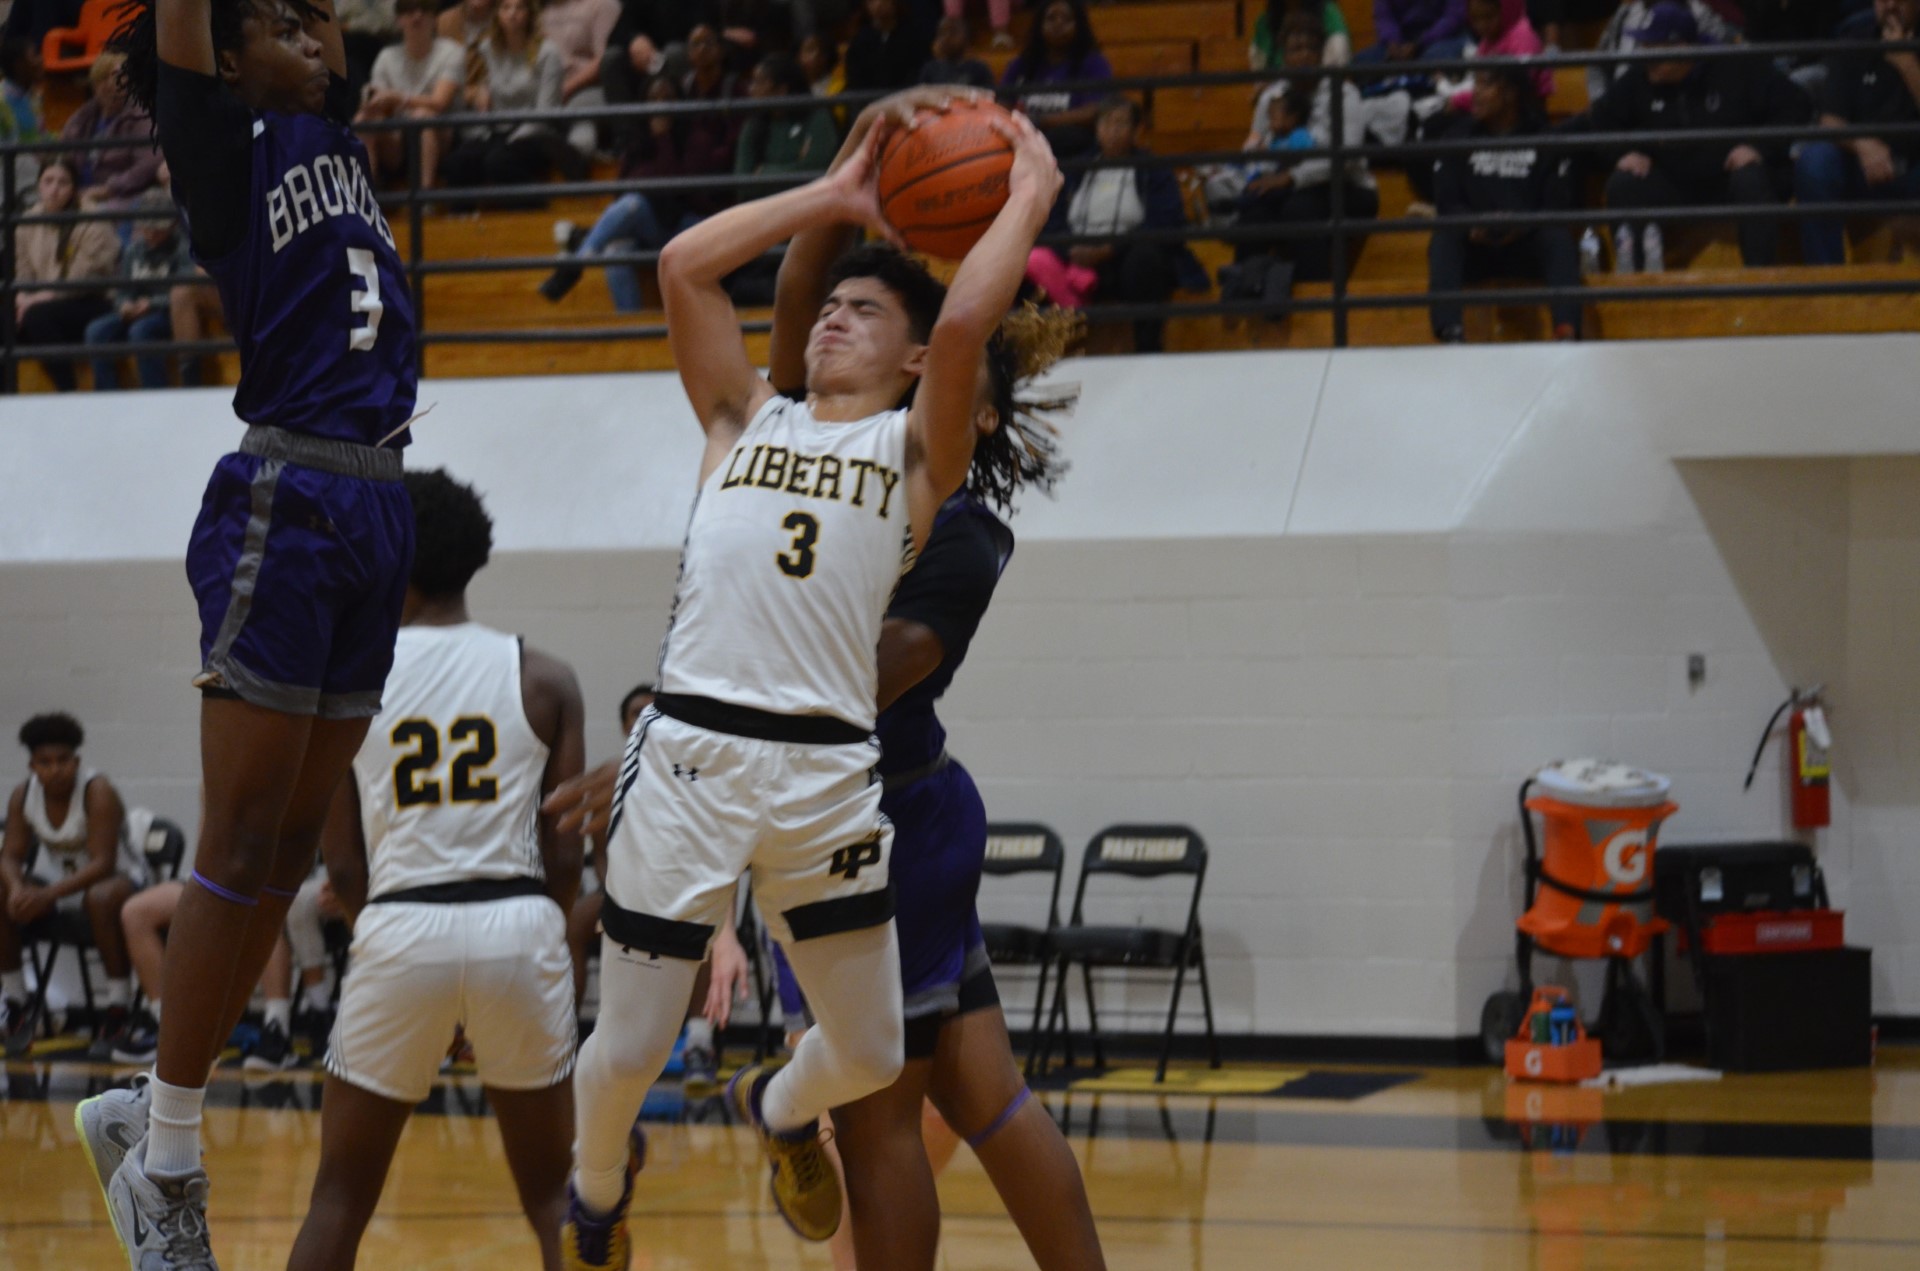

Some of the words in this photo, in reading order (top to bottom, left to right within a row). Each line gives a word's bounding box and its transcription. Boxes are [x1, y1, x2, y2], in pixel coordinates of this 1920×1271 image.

[347, 247, 384, 351] 3
[719, 444, 900, 519] LIBERTY
[775, 510, 820, 579] 3
[389, 712, 499, 813] 22
[1604, 829, 1648, 884] G
